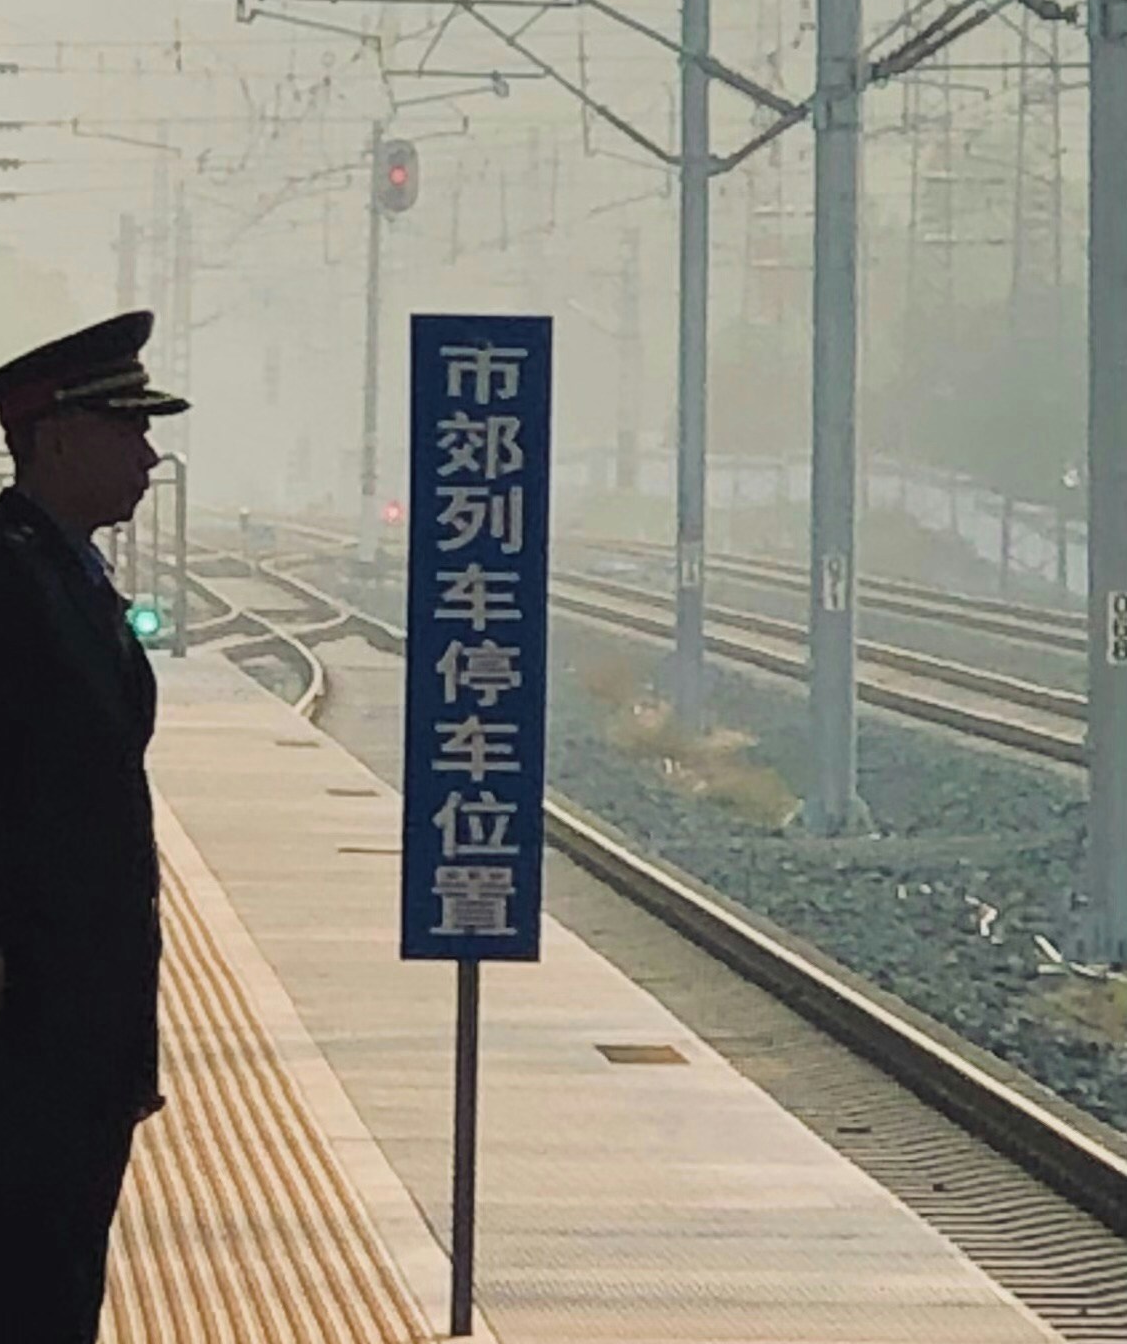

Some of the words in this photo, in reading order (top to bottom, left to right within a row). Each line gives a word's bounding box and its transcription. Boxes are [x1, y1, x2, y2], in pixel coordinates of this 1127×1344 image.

[430, 340, 529, 937] 市郊列车停车位置
